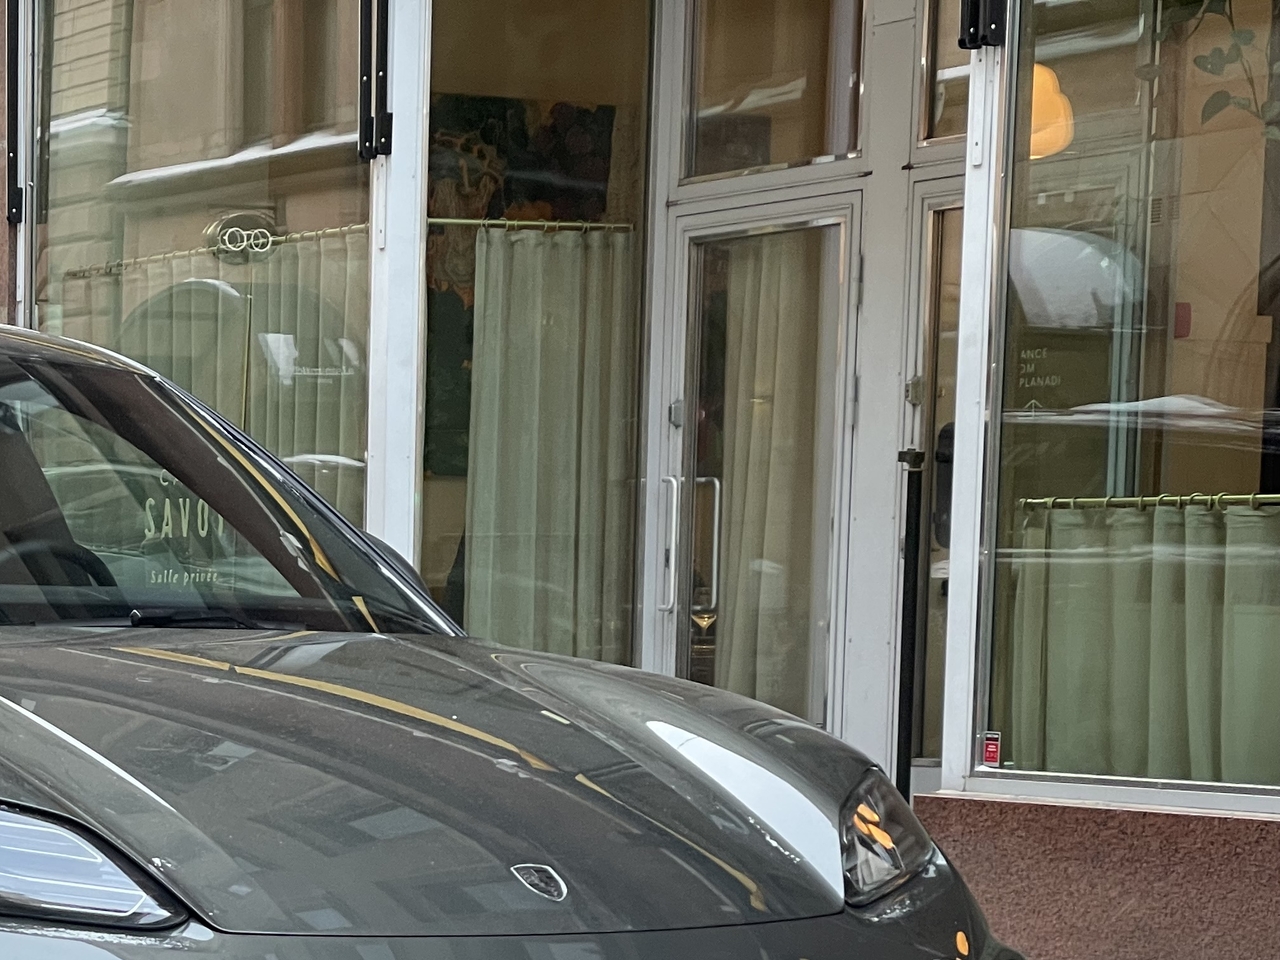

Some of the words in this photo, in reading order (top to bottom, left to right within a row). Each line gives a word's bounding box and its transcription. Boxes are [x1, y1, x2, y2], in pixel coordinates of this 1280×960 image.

[1021, 347, 1048, 359] ANCE
[1020, 363, 1035, 374] OM
[1019, 375, 1061, 388] PLANADI
[151, 569, 179, 583] Salle
